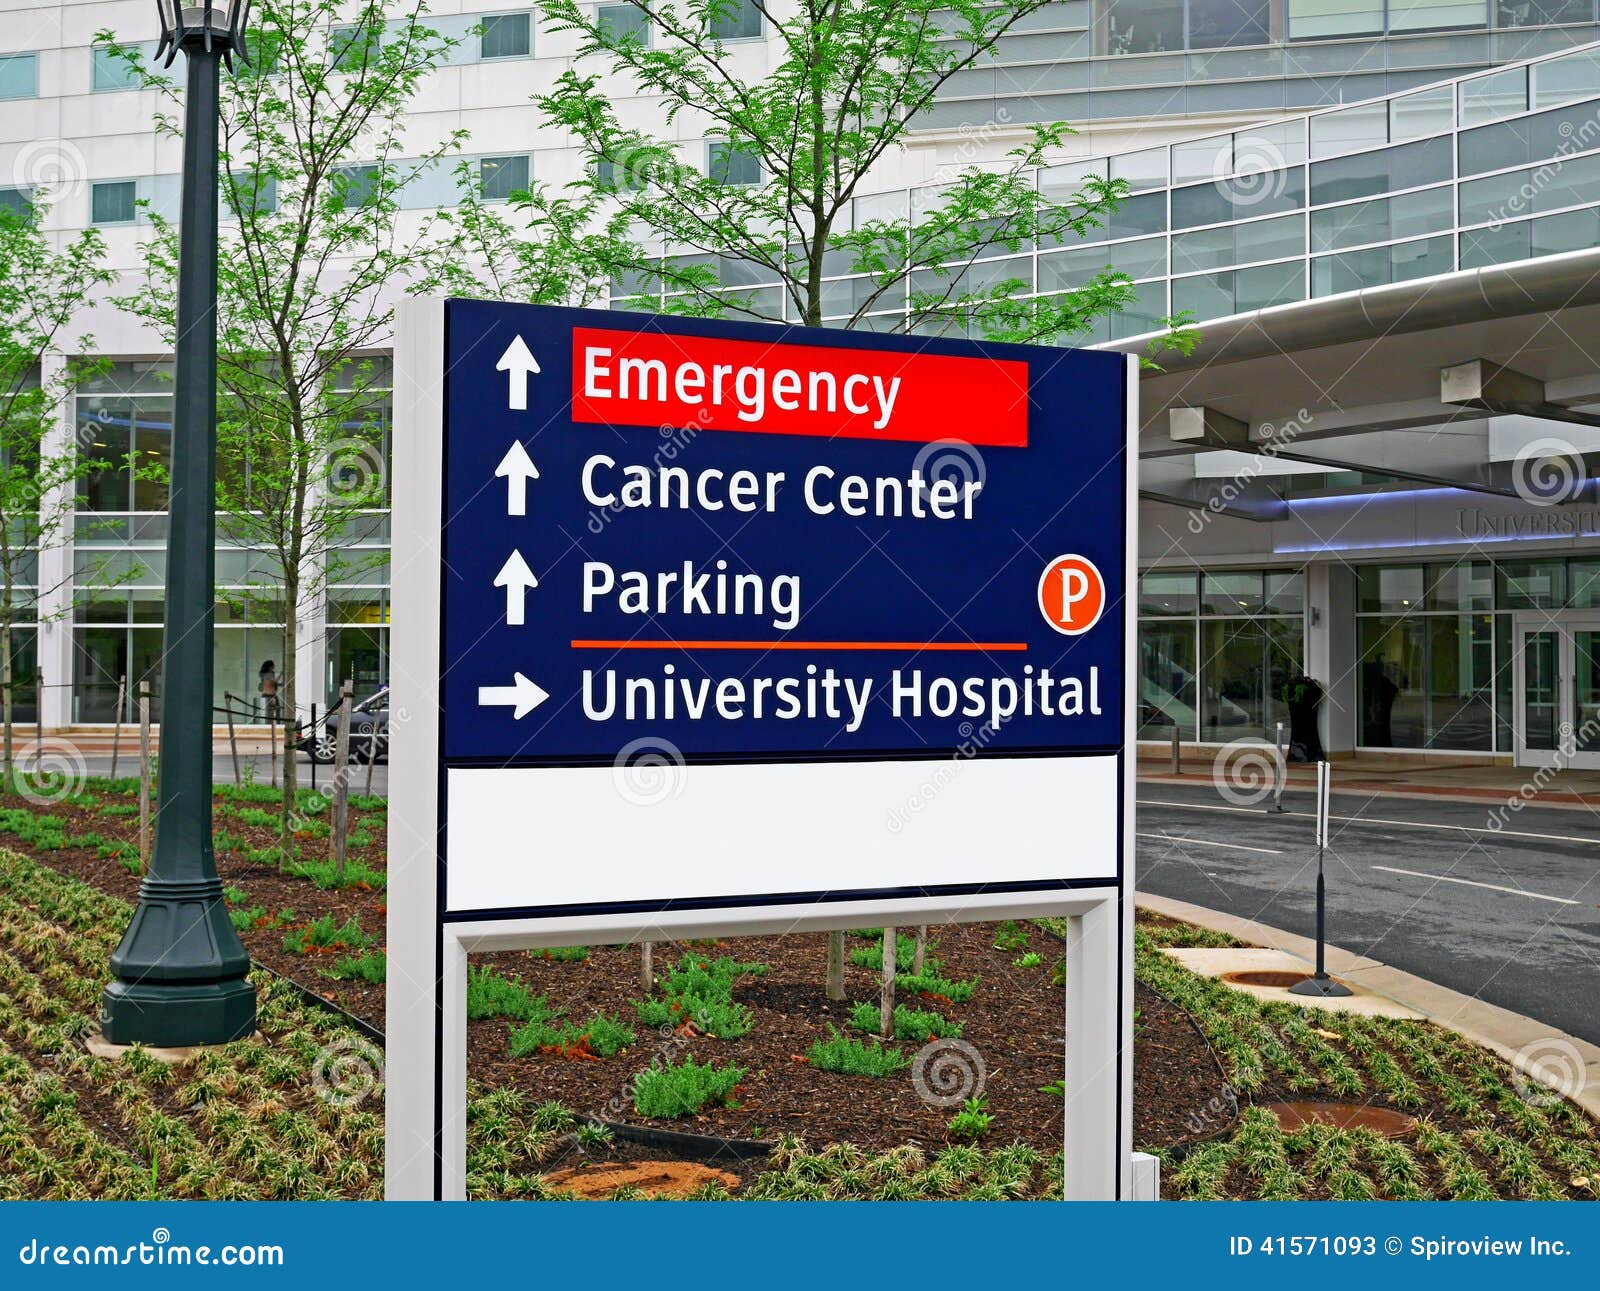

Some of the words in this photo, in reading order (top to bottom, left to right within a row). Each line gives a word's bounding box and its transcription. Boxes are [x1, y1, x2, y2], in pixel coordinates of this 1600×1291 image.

[585, 346, 901, 430] Emergency
[581, 454, 785, 512] Cancer
[804, 465, 982, 520] Center
[583, 559, 800, 630] Parking
[1059, 568, 1089, 623] P
[582, 664, 873, 732] University
[892, 664, 1102, 730] Hospital
